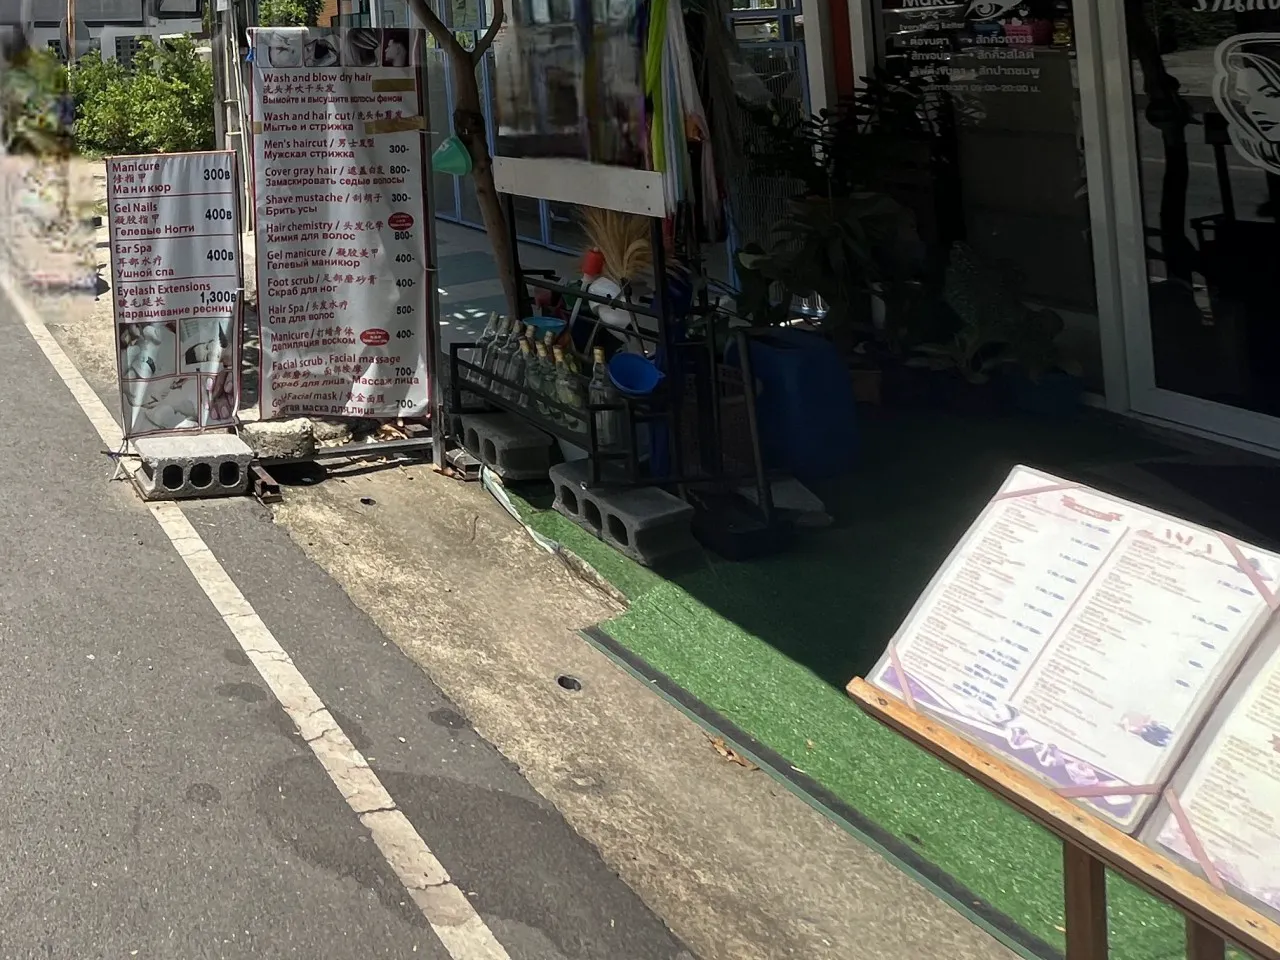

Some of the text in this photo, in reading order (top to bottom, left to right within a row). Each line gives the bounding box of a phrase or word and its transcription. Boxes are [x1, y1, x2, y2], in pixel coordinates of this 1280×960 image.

[264, 73, 372, 83] Wash and blow dry hair
[264, 112, 289, 121] Wash
[292, 112, 309, 121] and
[312, 111, 331, 120] hair
[310, 123, 353, 132] стрижка
[264, 140, 291, 149] Men's
[293, 138, 327, 148] haircut
[264, 150, 354, 160] Мужская стрижка
[112, 163, 160, 172] Manicure
[265, 167, 291, 177] Cover
[294, 168, 314, 176] gray
[317, 165, 337, 175] hair
[113, 184, 171, 194] Маникюр
[266, 195, 293, 204] Shave
[296, 193, 342, 203] mustache
[114, 202, 157, 213] Gel Nails
[266, 206, 317, 217] Брить усы
[115, 225, 195, 236] Гелевые Ногти
[266, 224, 285, 233] Hair
[288, 221, 333, 232] chemistry
[267, 234, 298, 243] Химия
[116, 244, 151, 255] Ear Spa
[268, 250, 282, 260] Gel
[285, 248, 326, 259] manicure
[267, 259, 360, 270] Гелевый маникюр
[117, 268, 174, 278] Ушной спа
[268, 278, 288, 287] Foot
[291, 275, 314, 286] scrub
[117, 282, 210, 298] Eyelash Extensions
[268, 285, 337, 298] Скраб для ног
[119, 305, 232, 320] наращивание ресниц
[268, 304, 285, 315] Hair
[288, 303, 304, 315] Spa
[269, 315, 285, 324] Спа
[288, 315, 306, 324] для
[271, 330, 309, 343] Manicure
[322, 337, 356, 345] воском
[272, 359, 297, 371] Facial
[330, 354, 355, 365] Facial
[359, 355, 400, 365] massage
[353, 375, 392, 385] Массаж
[288, 392, 312, 400] Facial
[314, 391, 337, 400] mask
[302, 403, 329, 412] маска
